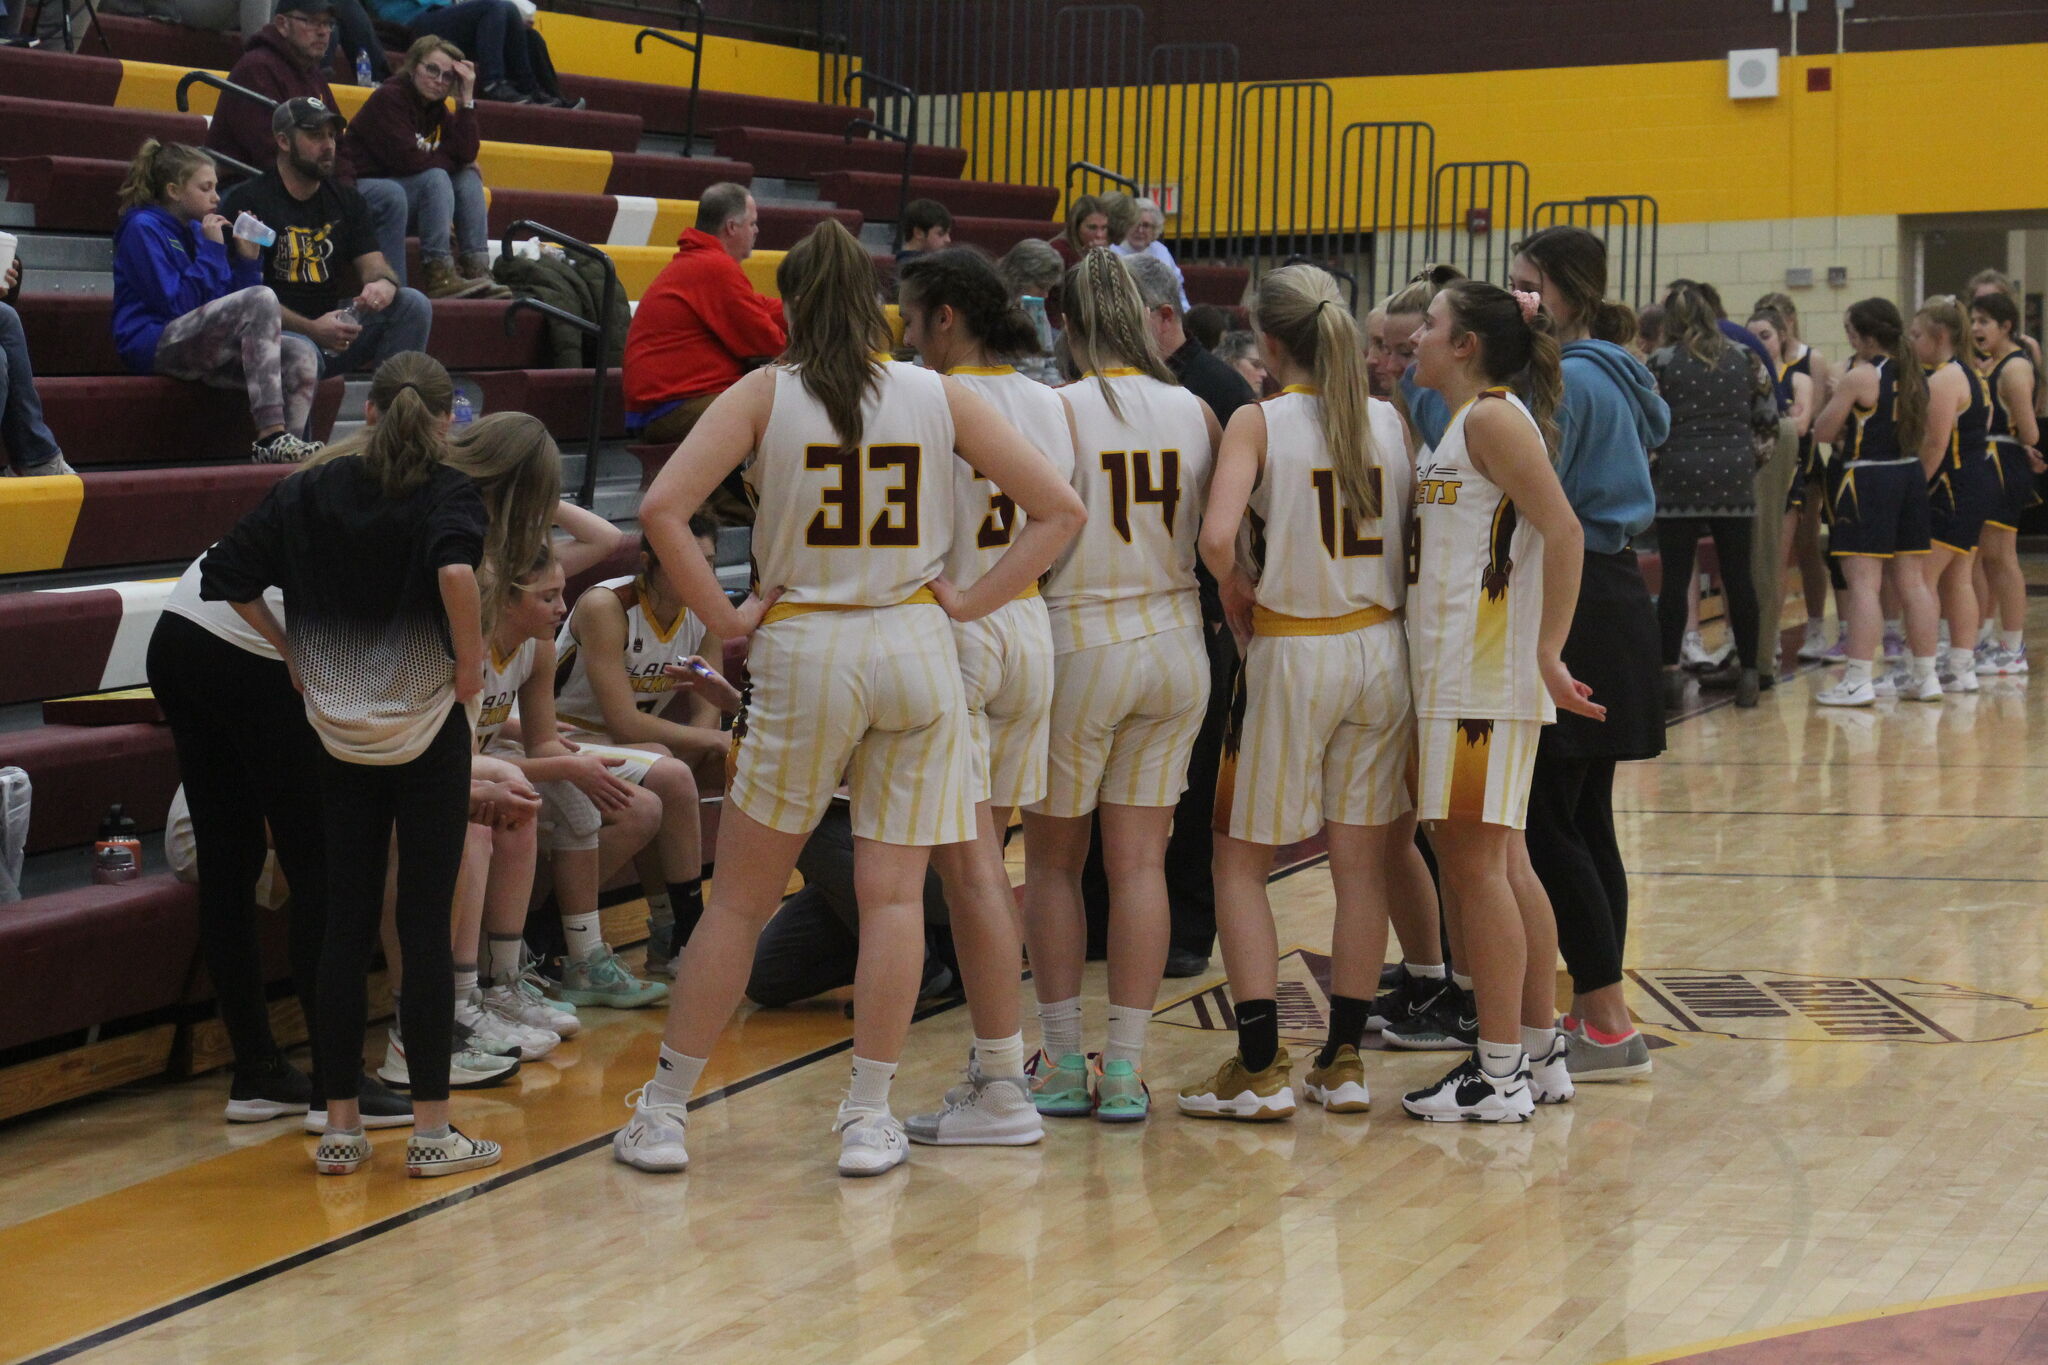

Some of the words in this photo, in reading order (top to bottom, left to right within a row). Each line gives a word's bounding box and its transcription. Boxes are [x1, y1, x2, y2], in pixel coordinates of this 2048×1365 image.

[803, 442, 922, 548] 33
[1099, 448, 1182, 545] 14
[1311, 465, 1384, 560] 12
[1763, 980, 1926, 1036] GREATER
